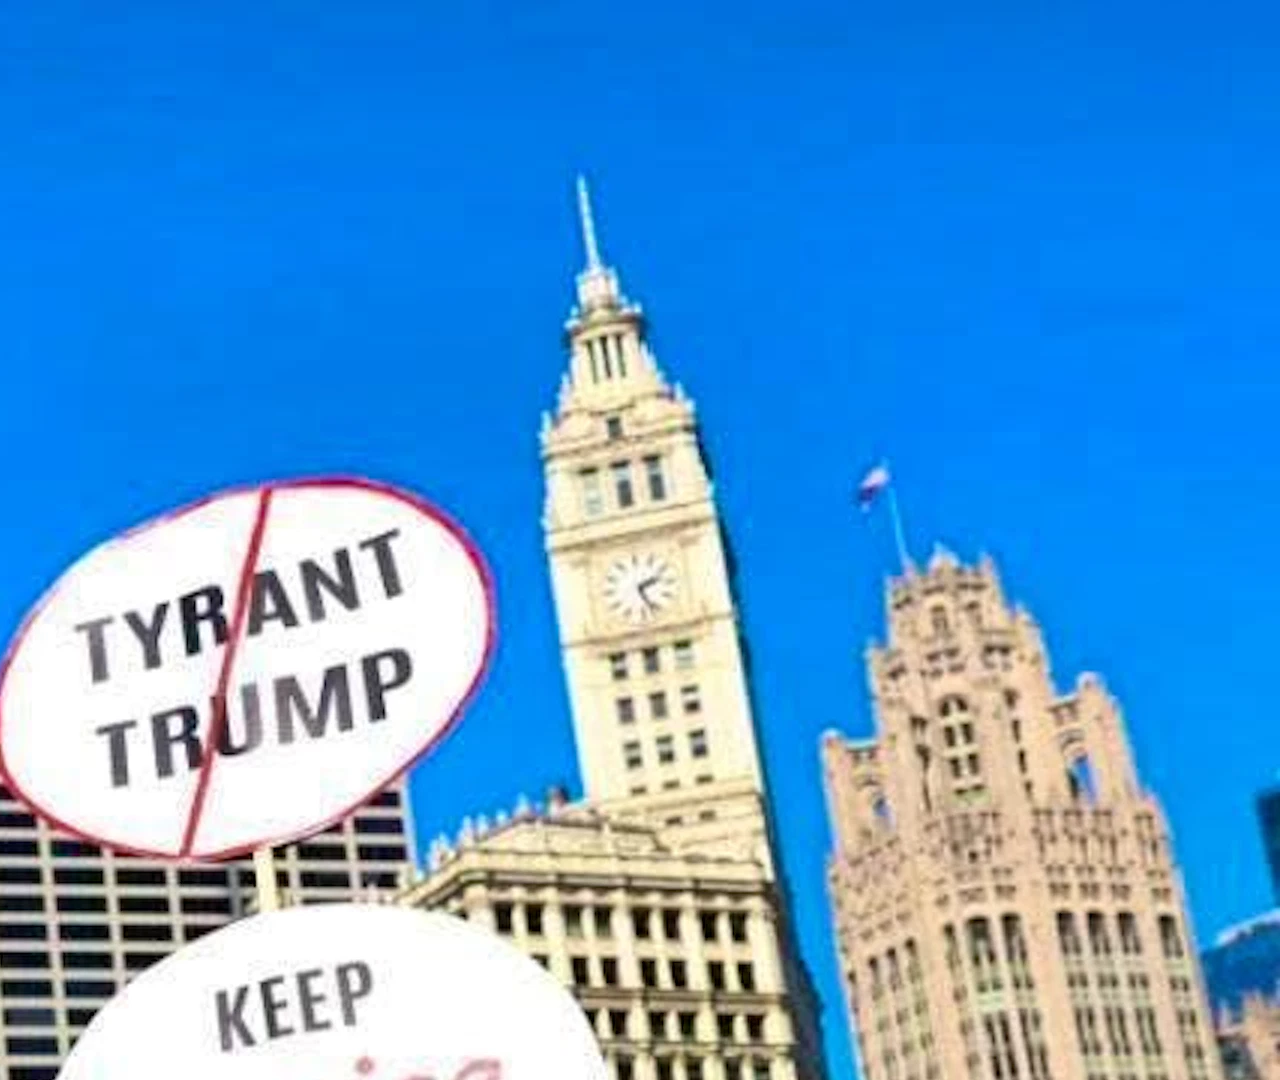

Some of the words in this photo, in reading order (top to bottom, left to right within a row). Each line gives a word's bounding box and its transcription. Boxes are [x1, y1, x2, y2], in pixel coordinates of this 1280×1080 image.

[75, 528, 403, 684] TYRANT
[96, 647, 414, 788] TRUMP
[214, 960, 375, 1053] KEEP
